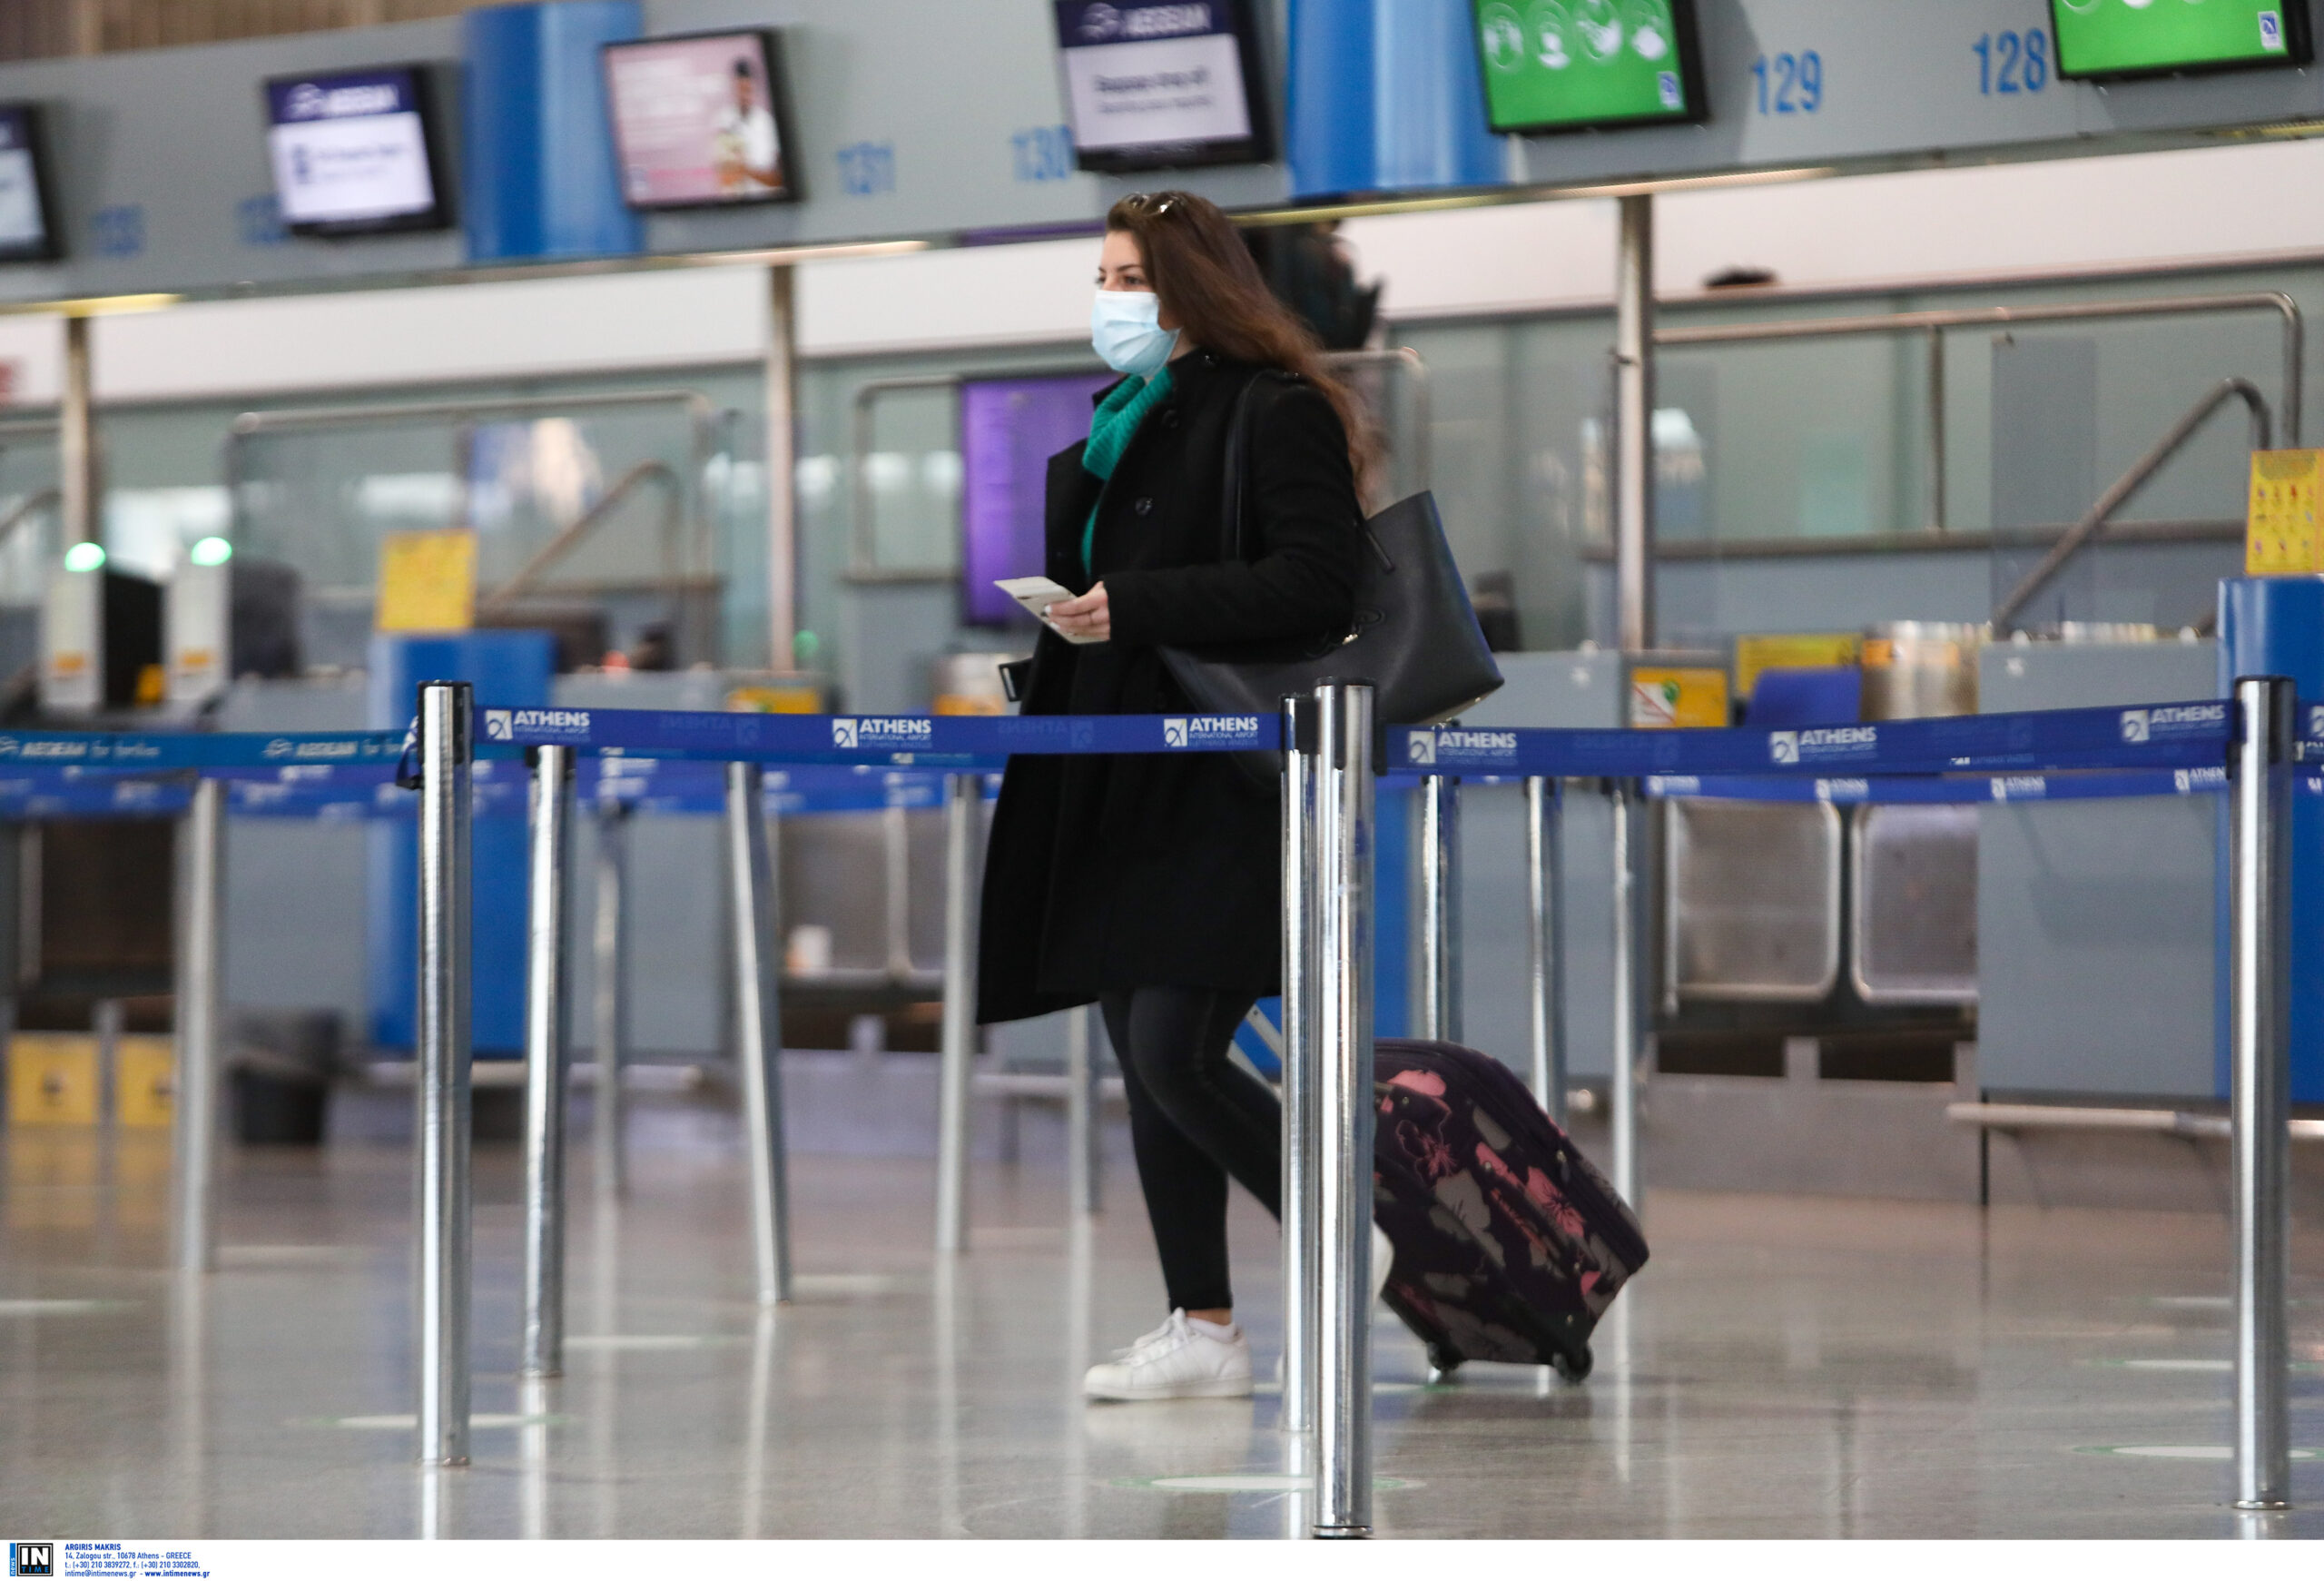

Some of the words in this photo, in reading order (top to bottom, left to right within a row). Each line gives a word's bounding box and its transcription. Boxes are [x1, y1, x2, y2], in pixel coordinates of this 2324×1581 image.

[1973, 27, 2048, 95] 128
[1753, 48, 1822, 114] 129
[514, 710, 590, 726] ATHENS
[2152, 705, 2225, 724] ATHENS
[859, 718, 931, 734] ATHENS
[1189, 716, 1258, 732] ATHENS
[1438, 731, 1518, 748] ATHENS
[1799, 726, 1878, 745] ATHENS
[2190, 766, 2227, 779] ATHEN
